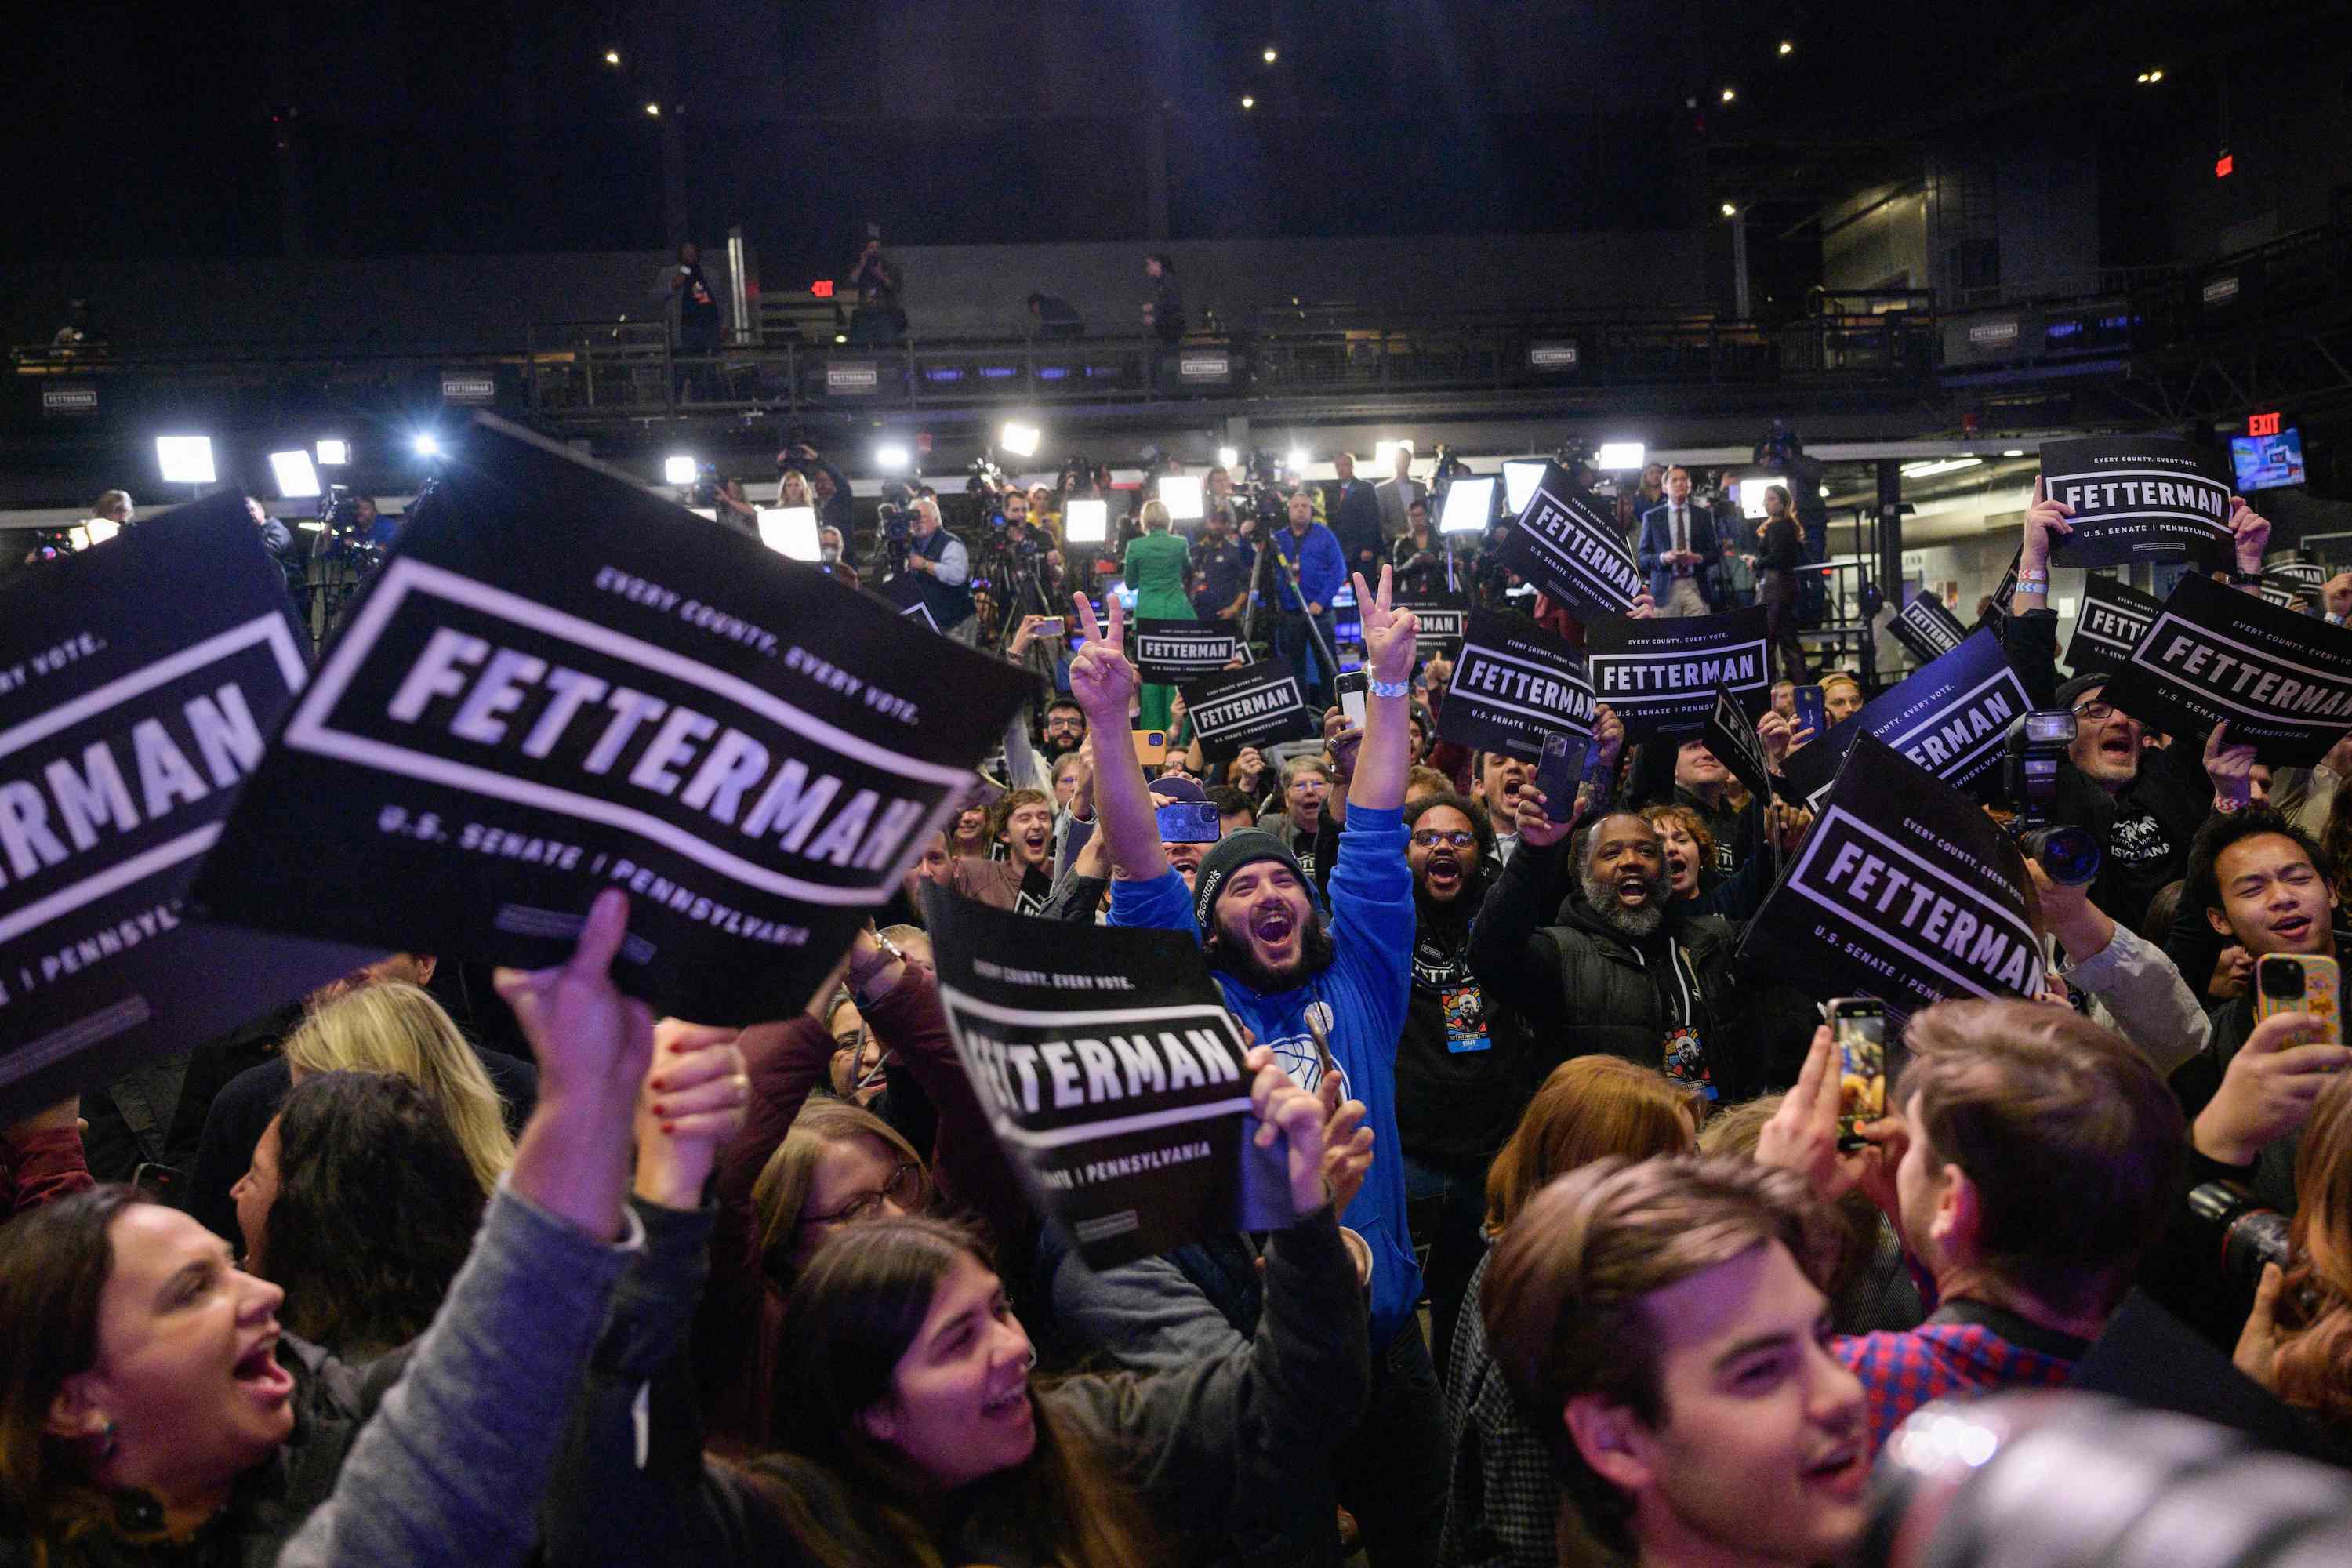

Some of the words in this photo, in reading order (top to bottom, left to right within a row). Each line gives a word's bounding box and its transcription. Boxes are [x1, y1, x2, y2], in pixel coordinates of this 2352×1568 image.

[2249, 412, 2280, 436] EXIT
[2180, 459, 2199, 468] VOTE.
[2066, 481, 2223, 517] FETTERMAN
[1535, 504, 1642, 597] FETTERMAN
[2108, 524, 2147, 535] SENATE
[2160, 524, 2216, 540] PENNSYLVANIA
[1544, 557, 1567, 576] SENATE
[1573, 577, 1616, 613] PENNSYLVANIA
[594, 565, 680, 612] EVERY
[680, 599, 778, 658] COUNTY.
[785, 645, 862, 697] EVERY
[1507, 639, 1527, 652] EVERY
[1709, 632, 1729, 641] VOTE.
[1909, 608, 1957, 652] FETTERM
[2092, 609, 2148, 641] FETT
[2232, 620, 2265, 637] EVERY
[2266, 633, 2305, 652] COUNTY.
[2308, 648, 2339, 661] EVERY
[1146, 641, 1228, 659] FETTERMAN
[1468, 659, 1597, 722] FETTERMAN
[1603, 654, 1754, 691] FETTERMAN
[1198, 687, 1290, 729] FETTERMAN
[1471, 709, 1488, 720] U.S.
[1491, 713, 1524, 730] SENATE
[1637, 707, 1671, 716] SENATE
[1904, 699, 1929, 719] EVERY
[1929, 683, 1955, 701] VOTE.
[2158, 687, 2180, 703] U.S.
[2185, 701, 2231, 727] SENATE
[387, 627, 925, 872] FETTERMAN
[0, 682, 267, 889] RMAN
[459, 822, 583, 870] SENATE
[1903, 817, 1935, 842] EVERY
[1936, 837, 1979, 869] COUNTY.
[1980, 865, 2008, 889] EVERY
[1824, 840, 2045, 998] FETTERMAN
[41, 902, 183, 982] PENNSYL
[1814, 924, 1839, 947] U.S.
[1844, 942, 1896, 978] SENATE
[1085, 1140, 1211, 1184] PENNSYLVANIA
